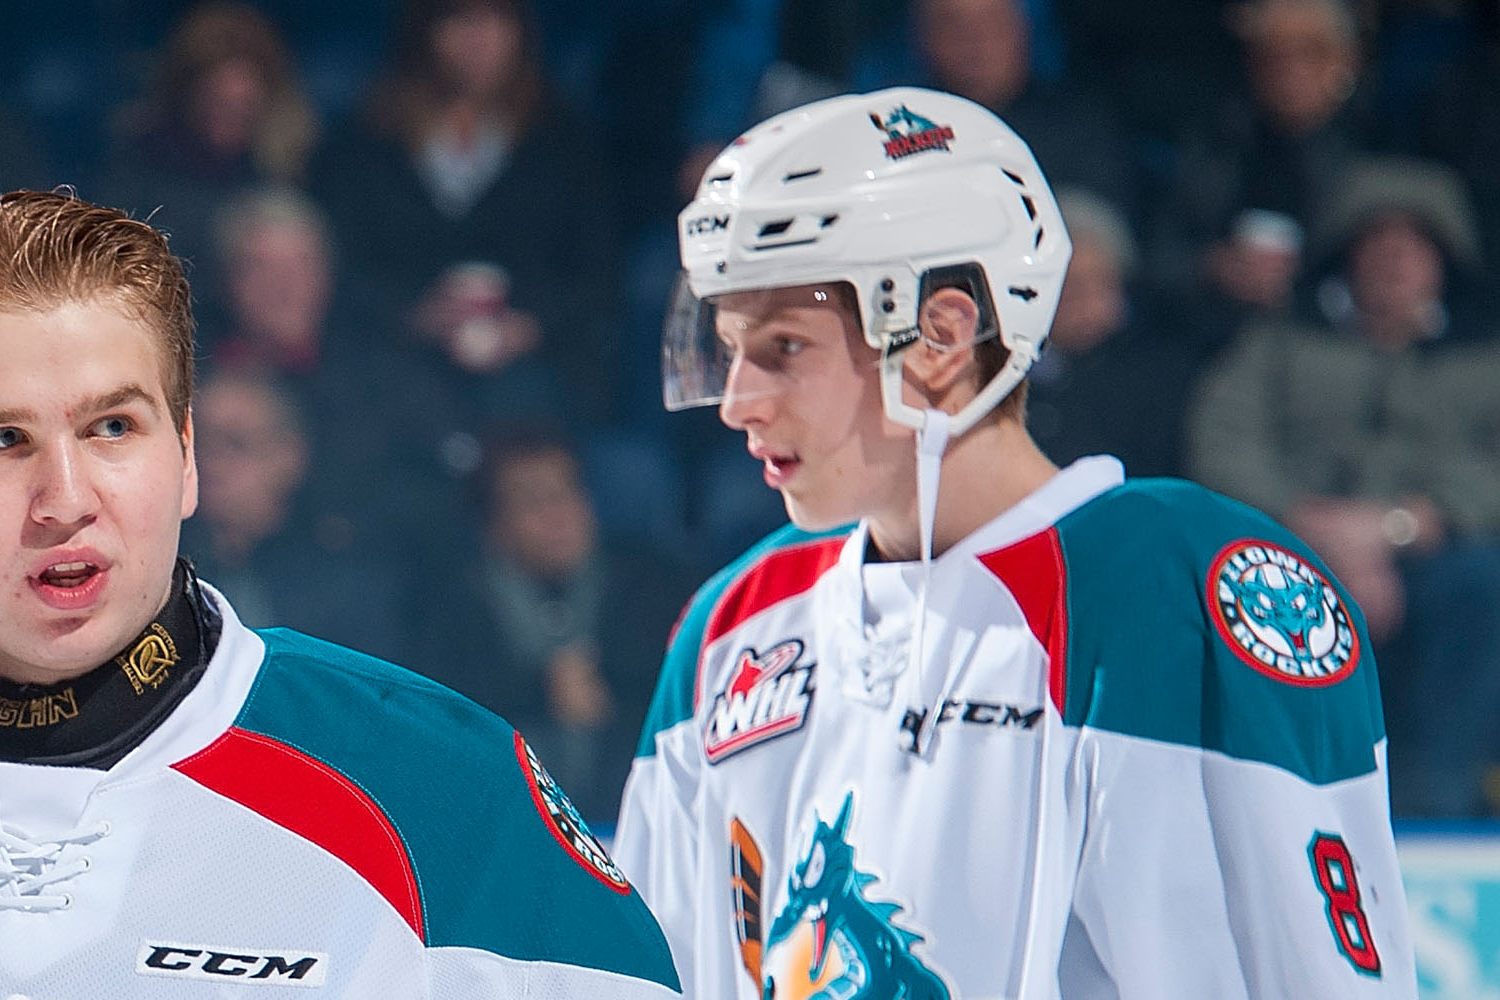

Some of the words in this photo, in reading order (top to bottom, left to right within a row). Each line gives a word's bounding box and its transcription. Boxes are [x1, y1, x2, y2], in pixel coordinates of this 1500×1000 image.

[1232, 621, 1354, 677] ROCKETS
[713, 667, 809, 743] WHL
[937, 699, 1045, 730] CCM
[1306, 830, 1382, 979] 8
[145, 945, 318, 980] CCM
